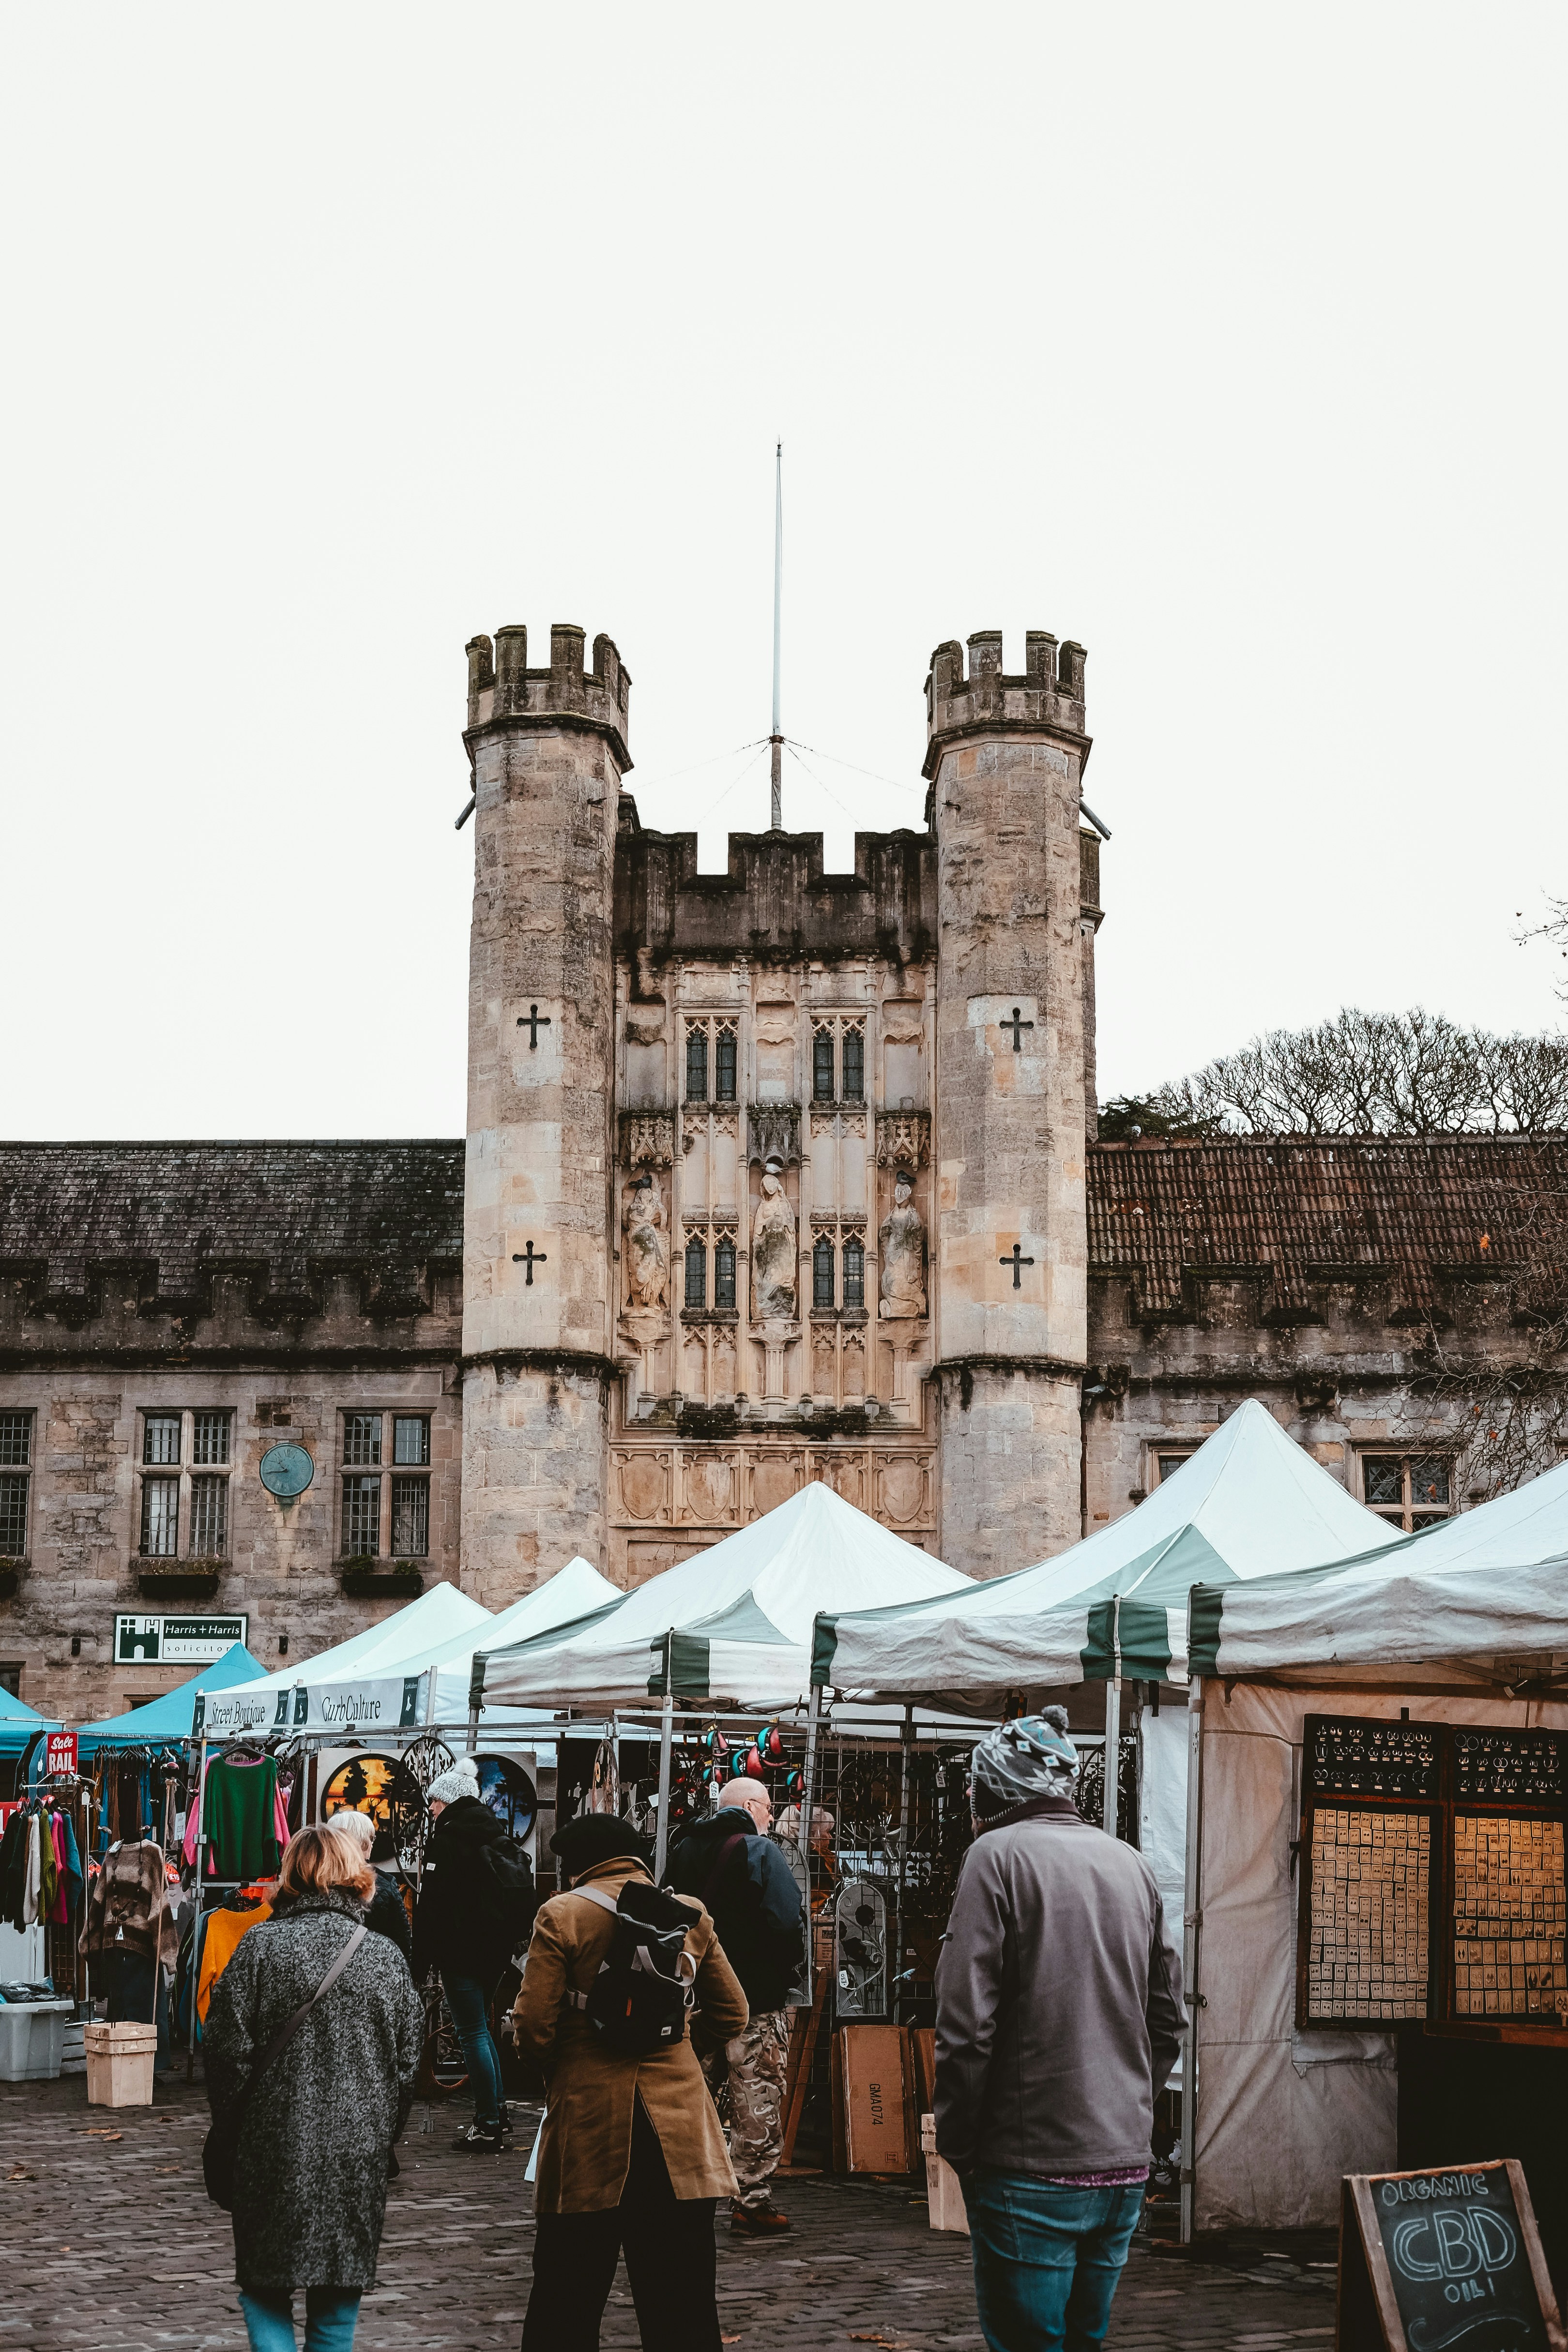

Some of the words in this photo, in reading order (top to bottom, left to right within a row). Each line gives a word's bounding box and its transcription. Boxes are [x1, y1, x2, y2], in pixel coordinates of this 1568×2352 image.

[165, 1625, 196, 1634] Harris
[199, 1625, 207, 1634] +
[208, 1625, 240, 1634] Harris
[213, 1702, 232, 1724] Street
[233, 1700, 265, 1724] Boutique
[322, 1693, 381, 1722] CurbCulture
[51, 1736, 73, 1749] Sale
[49, 1752, 75, 1772] RAIL
[869, 2084, 883, 2125] GMA074
[1382, 2174, 1489, 2206] ORGANIC
[1393, 2206, 1516, 2281] CBD
